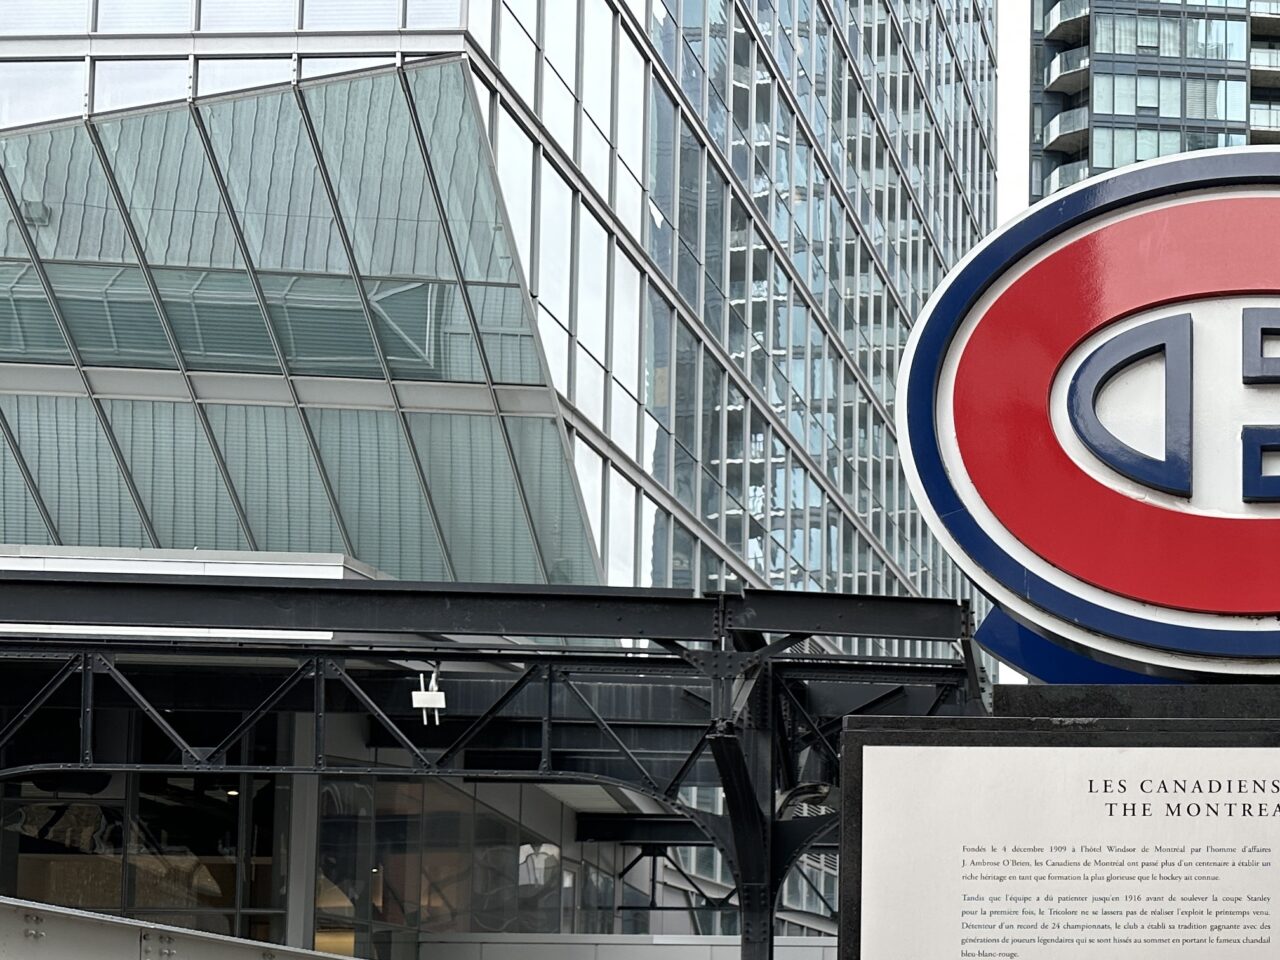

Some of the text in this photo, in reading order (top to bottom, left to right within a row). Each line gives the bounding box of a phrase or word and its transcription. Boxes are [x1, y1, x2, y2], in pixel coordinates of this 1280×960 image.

[1088, 779, 1128, 793] LES
[1140, 779, 1280, 793] CANADIENS
[1105, 803, 1153, 817] THE
[1154, 845, 1186, 853] Montréal
[1190, 847, 1202, 855] par
[1206, 845, 1237, 853] l'homme
[1241, 845, 1272, 853] d'affaires
[970, 859, 1001, 867] Ambrose
[1034, 859, 1044, 867] les
[1141, 860, 1159, 869] passé
[1160, 859, 1176, 870] plus
[1177, 859, 1193, 867] d'un
[1195, 859, 1230, 867] centenaire
